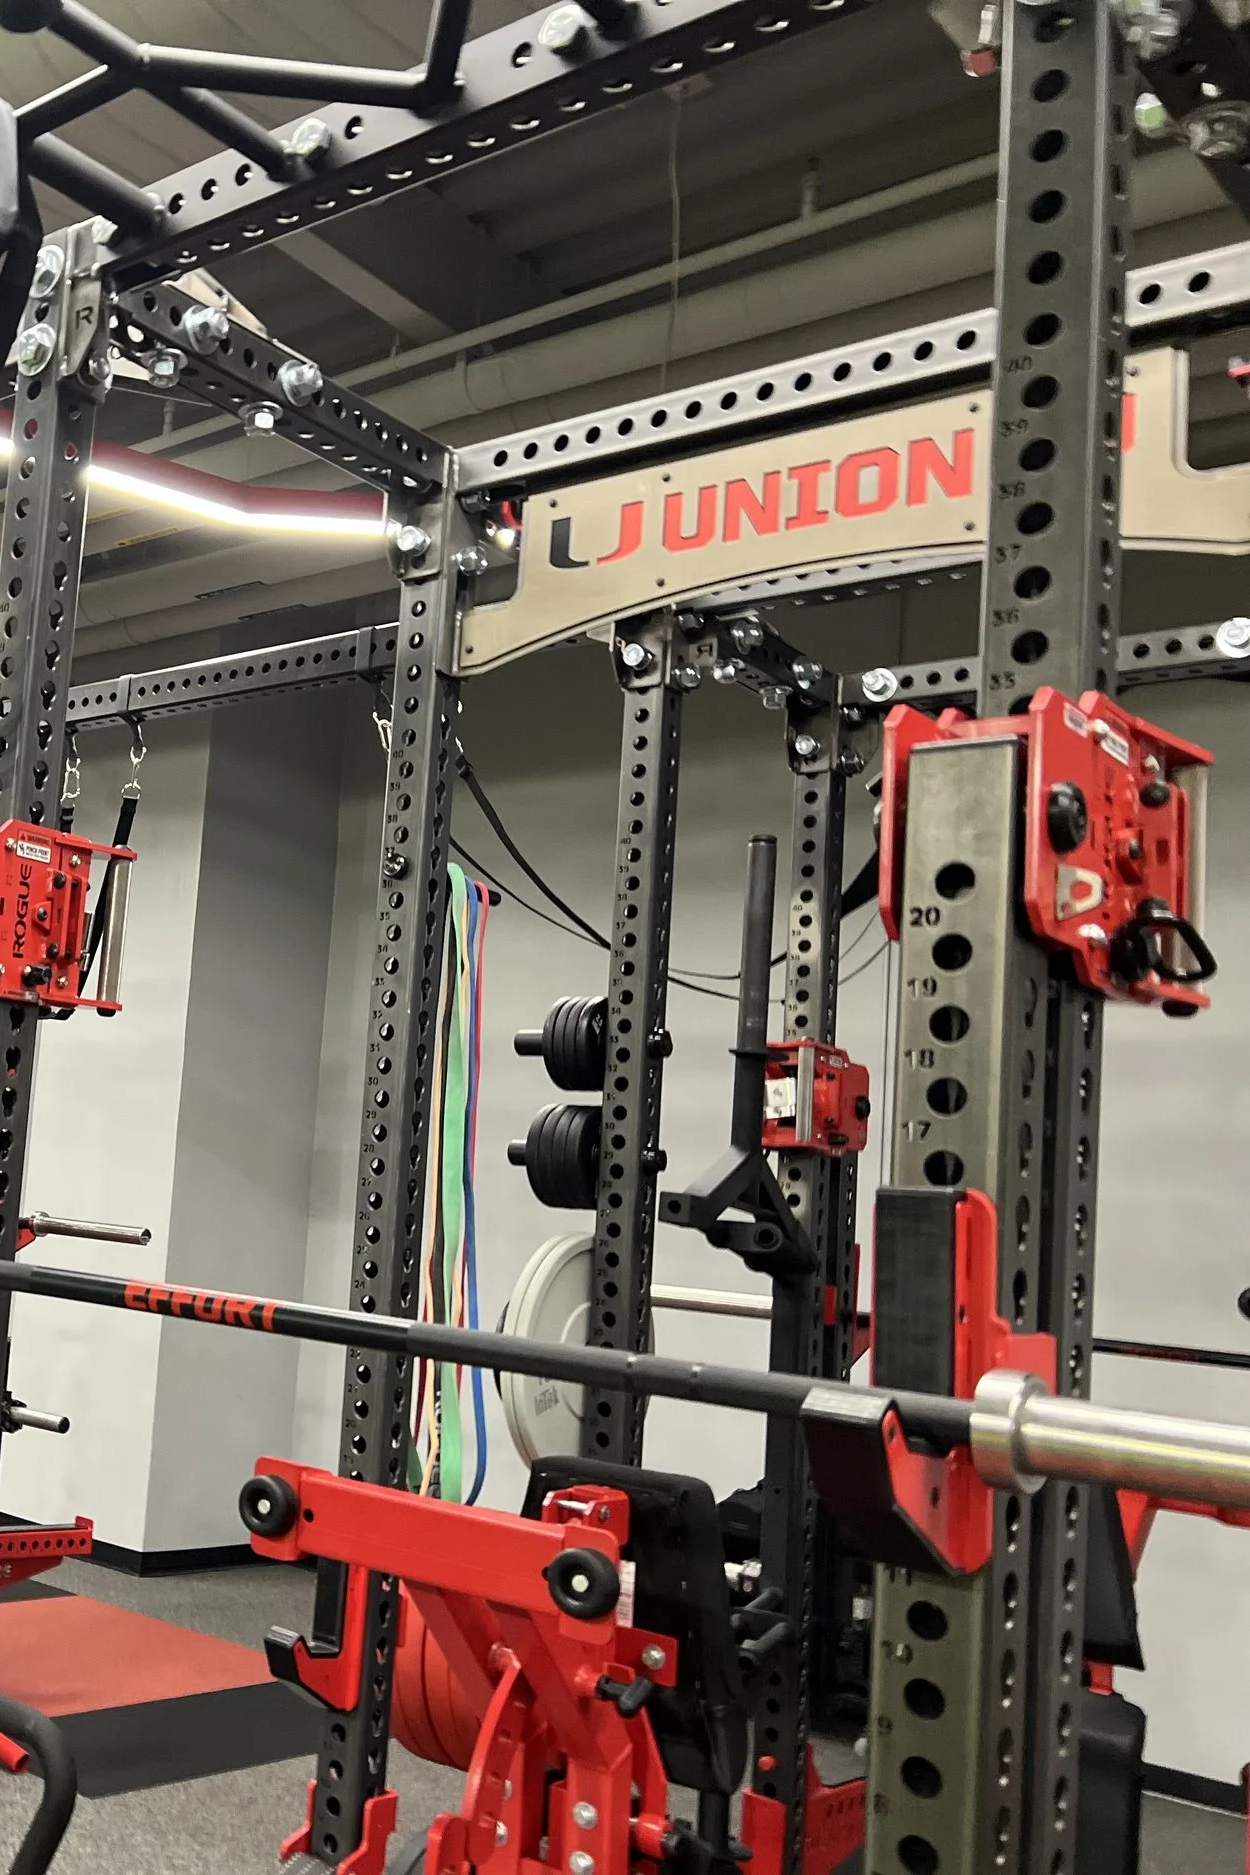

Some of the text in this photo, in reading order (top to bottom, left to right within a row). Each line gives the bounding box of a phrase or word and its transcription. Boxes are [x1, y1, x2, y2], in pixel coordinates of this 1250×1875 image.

[75, 306, 94, 327] R
[661, 428, 975, 553] UNION
[12, 863, 33, 959] ROGUE
[909, 907, 941, 927] 20
[907, 976, 938, 998] 19
[904, 1048, 934, 1070] 18
[367, 1077, 378, 1086] 30
[901, 1120, 931, 1142] 17
[124, 1280, 278, 1332] EFFORT
